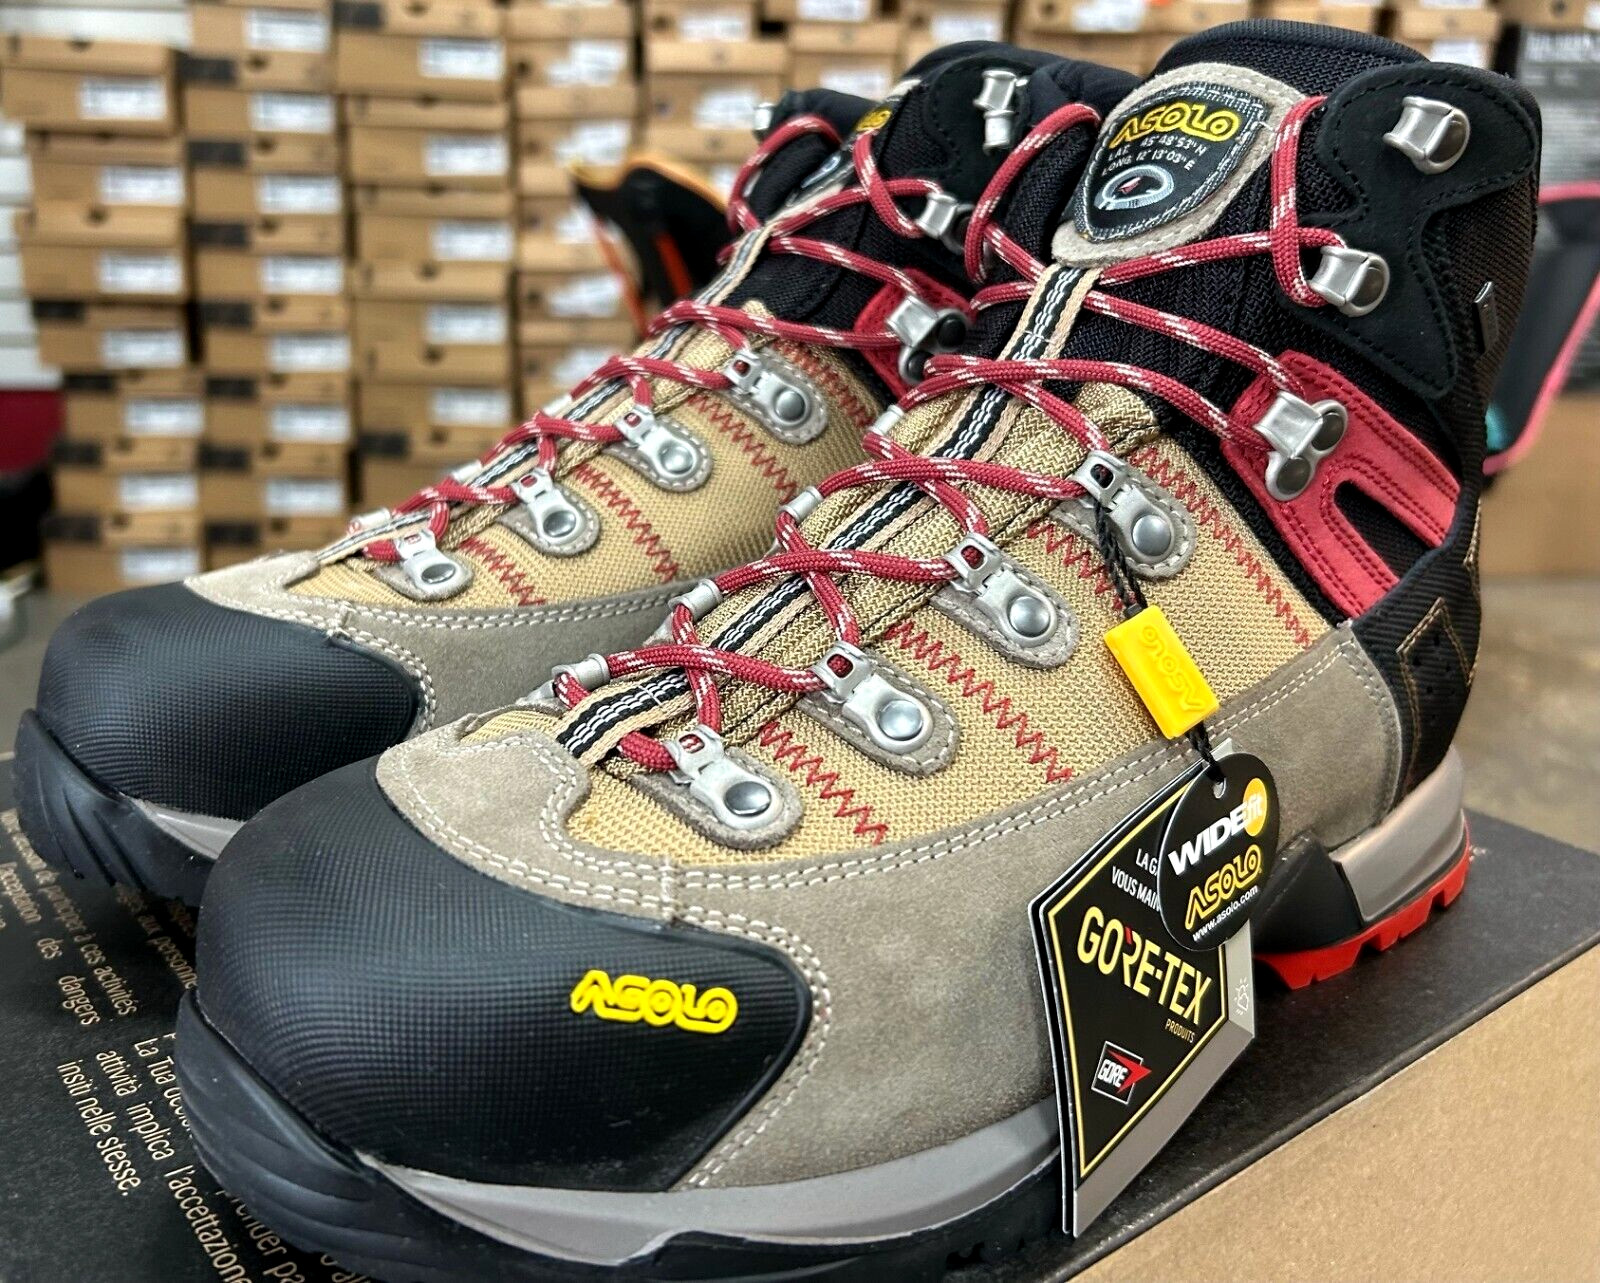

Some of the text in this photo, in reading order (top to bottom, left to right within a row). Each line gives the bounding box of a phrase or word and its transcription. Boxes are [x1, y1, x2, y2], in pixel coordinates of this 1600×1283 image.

[1109, 102, 1241, 149] ASOLO
[1142, 624, 1207, 712] ASOLO
[1111, 865, 1138, 896] VOUS
[1135, 848, 1149, 871] LA
[1184, 844, 1262, 930] ASOLO
[1191, 885, 1259, 943] www.asolo.com
[37, 937, 64, 960] des
[58, 975, 100, 1026] dangers
[80, 943, 106, 965] ces
[93, 965, 138, 1015] activités
[1077, 906, 1212, 1025] GORE-TEX
[570, 969, 739, 1034] ASOLO
[1164, 1018, 1196, 1044] PRODUITS
[134, 1038, 160, 1057] La
[146, 1056, 177, 1085] Tua
[1097, 1059, 1129, 1088] GORE
[57, 1059, 142, 1196] insiti nelle stesse.
[95, 1050, 143, 1097] attività
[126, 1100, 175, 1161] implica
